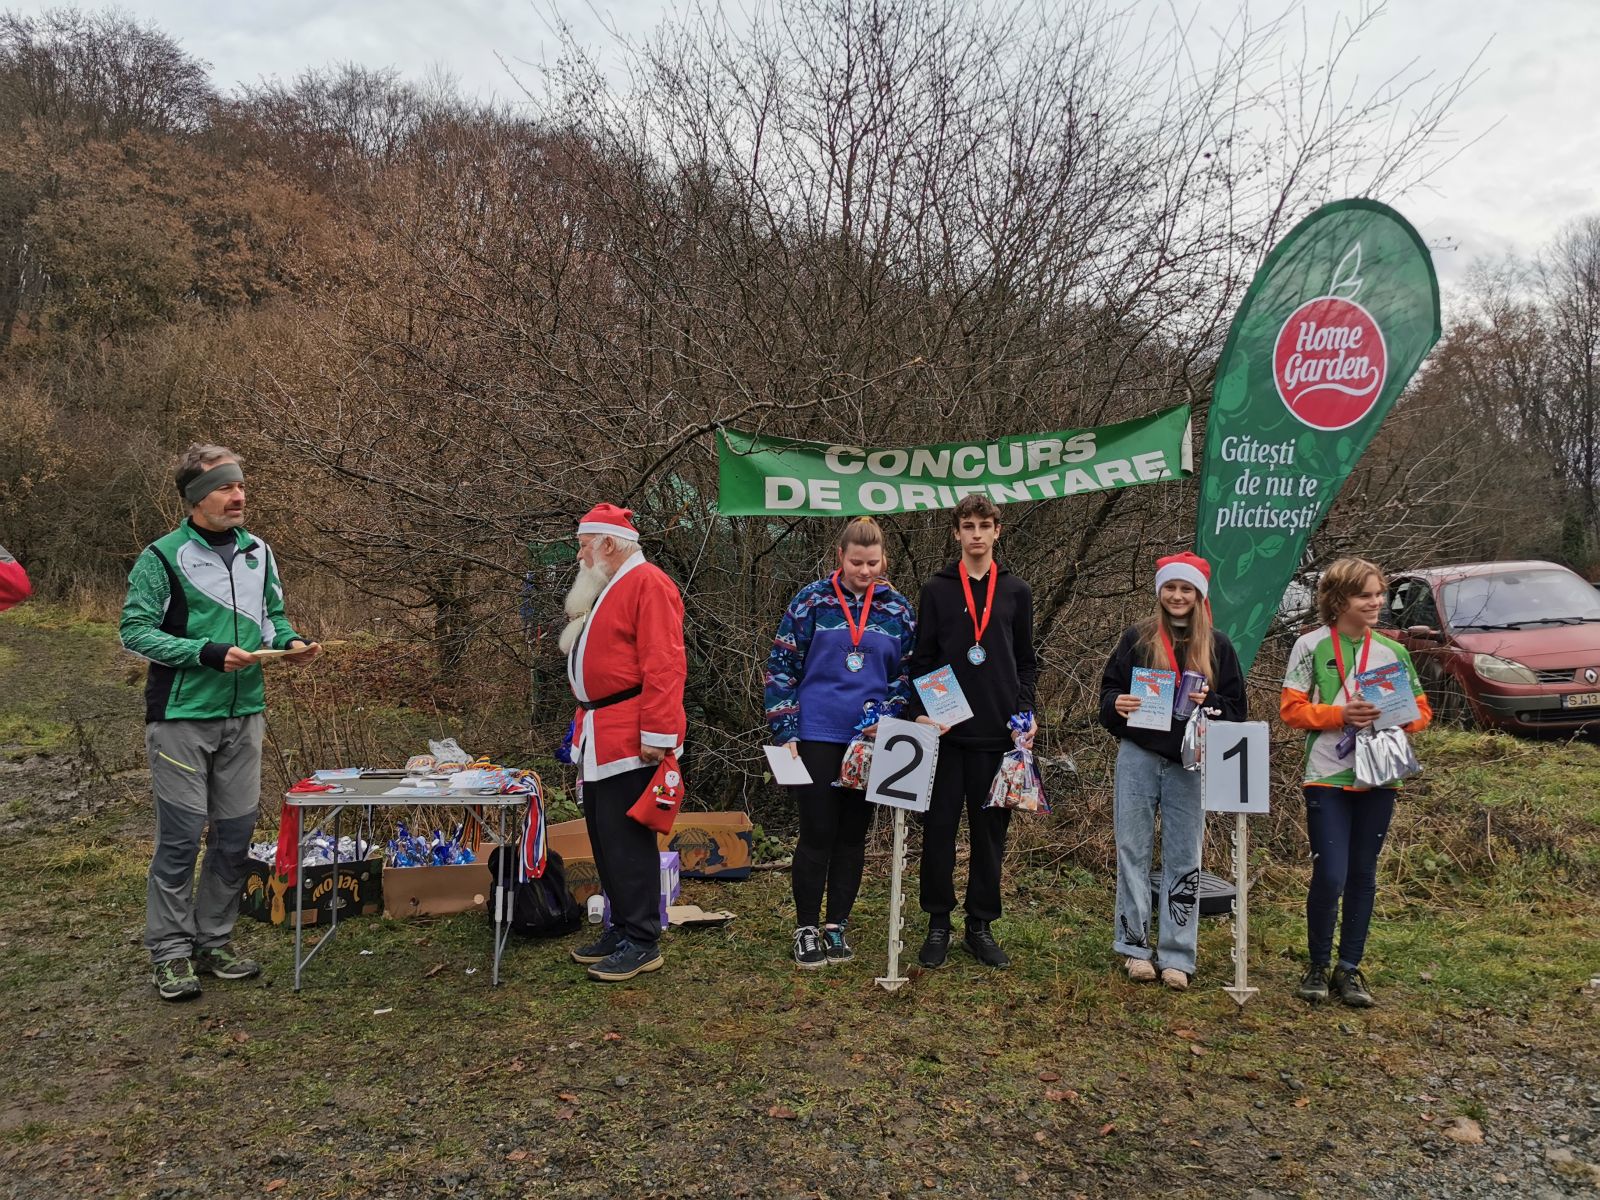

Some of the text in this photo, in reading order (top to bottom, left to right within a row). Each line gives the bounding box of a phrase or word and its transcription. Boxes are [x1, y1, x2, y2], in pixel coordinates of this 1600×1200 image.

[1296, 322, 1362, 352] Home
[1283, 350, 1379, 390] Garden
[825, 432, 1097, 479] CONCURS
[1221, 435, 1296, 471] Gătești
[765, 476, 842, 510] DE
[1234, 469, 1318, 498] de nu te
[1215, 501, 1321, 536] plictisești!
[876, 734, 924, 802] 2
[1223, 737, 1249, 803] 1
